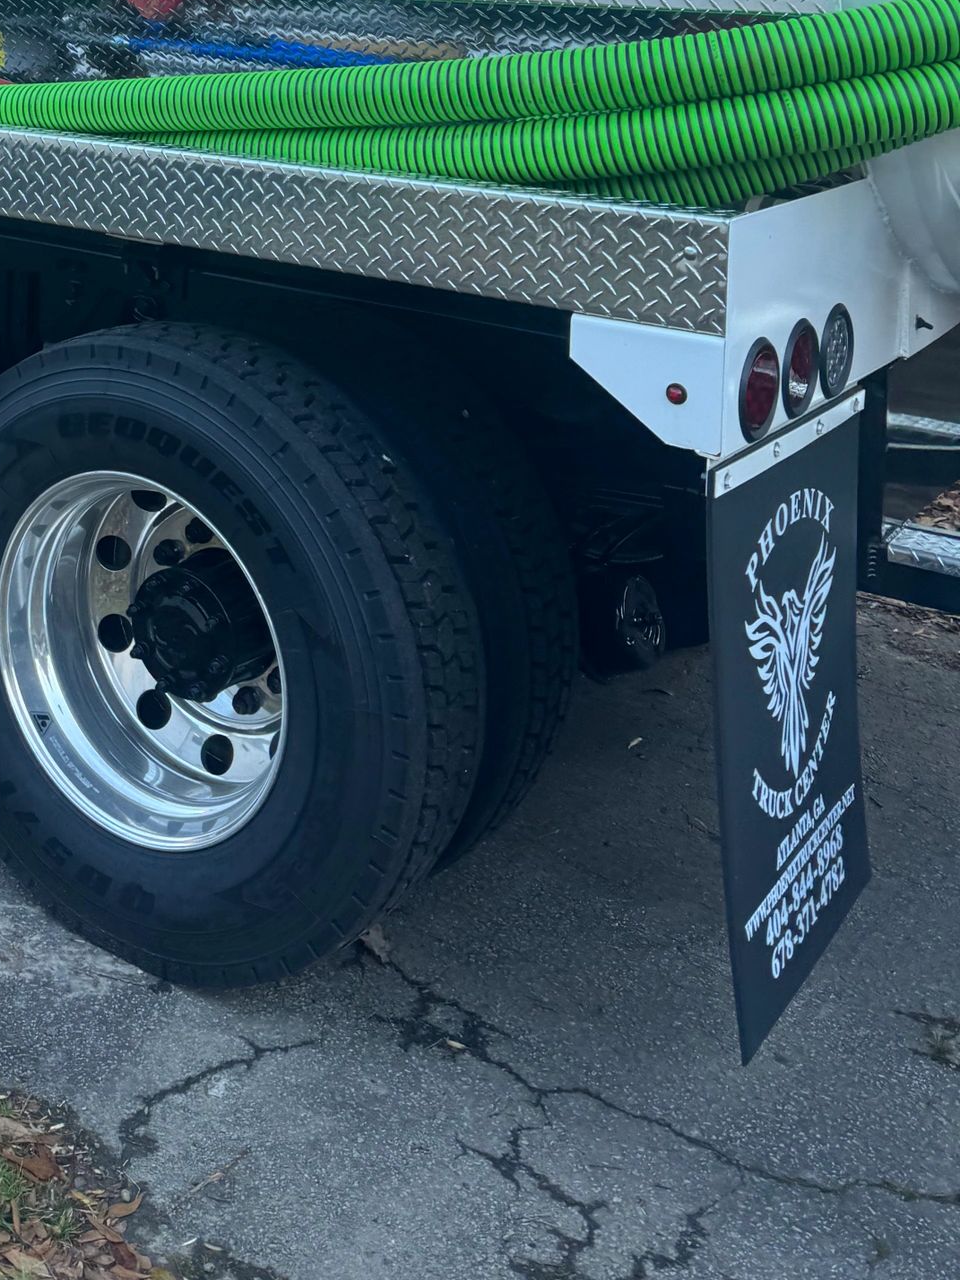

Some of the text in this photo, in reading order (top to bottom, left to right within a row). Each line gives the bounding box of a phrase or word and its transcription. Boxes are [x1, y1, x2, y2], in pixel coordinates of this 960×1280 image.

[744, 487, 835, 593] PHOENIX
[751, 690, 837, 820] TRUCK CENTER
[744, 783, 856, 943] WWW.PHOENIXTRUCKCENTER.NET
[766, 823, 844, 947] 404-844-8968
[776, 793, 826, 872] ATLANTA, GA
[771, 856, 846, 980] 678-371-4782
